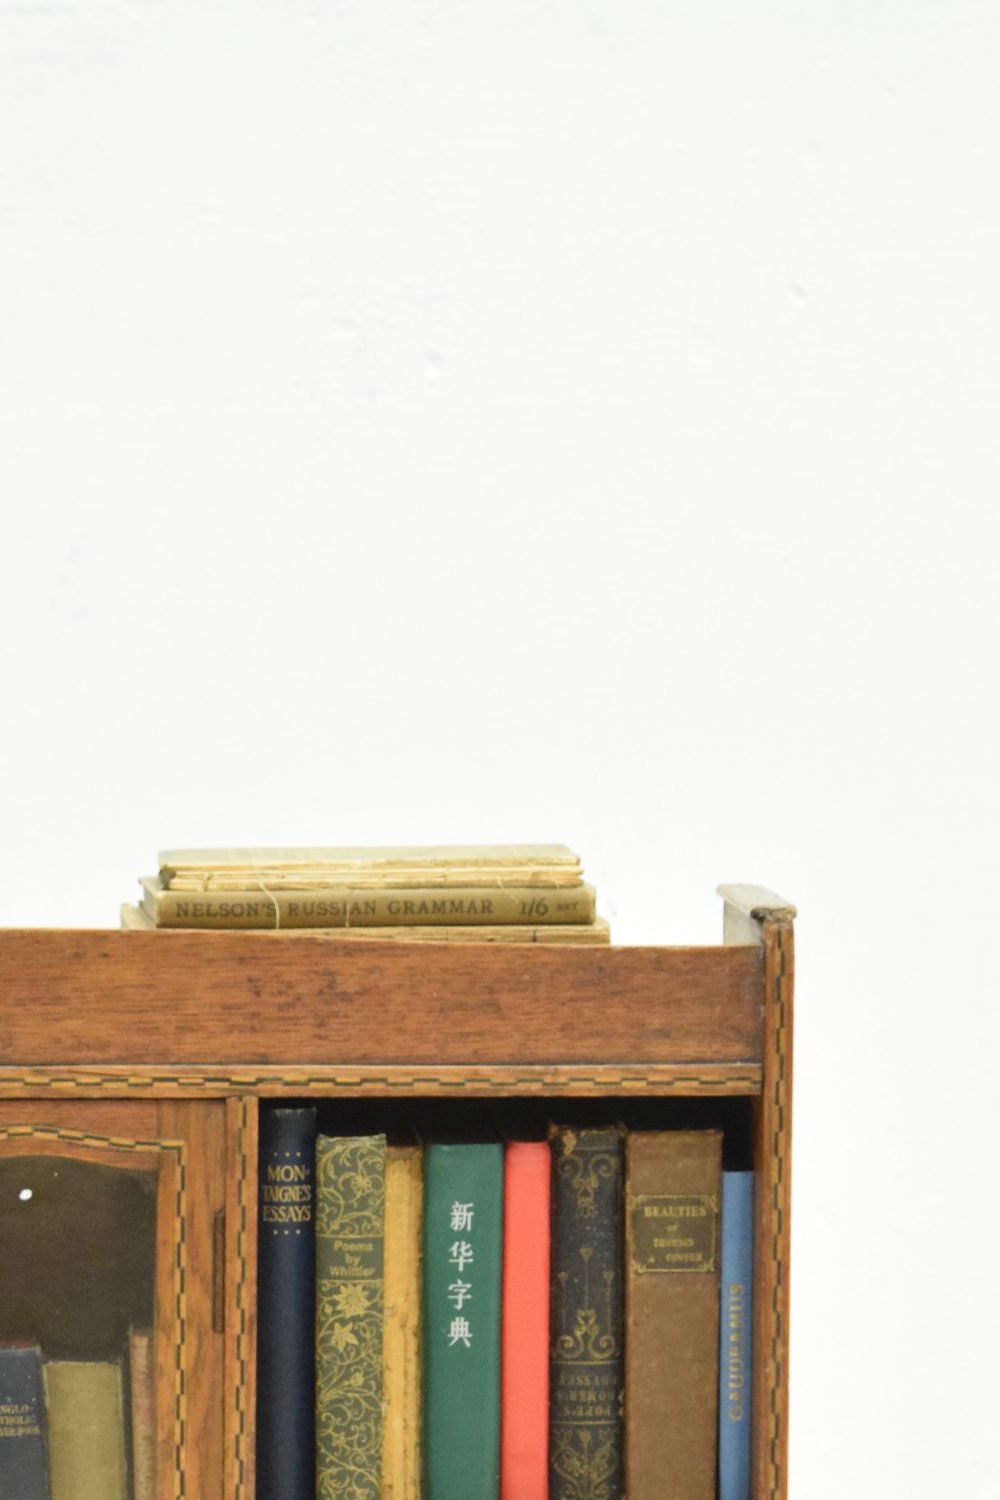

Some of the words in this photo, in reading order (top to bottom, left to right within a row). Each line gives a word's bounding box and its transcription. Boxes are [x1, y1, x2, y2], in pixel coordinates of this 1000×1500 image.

[176, 902, 277, 919] NELSON'S
[288, 900, 377, 918] RUSSIAN
[388, 898, 494, 916] GRAMMAR
[520, 897, 548, 918] 1/6
[267, 1165, 311, 1182] MON-
[263, 1184, 311, 1201] TAIGNE'S
[263, 1205, 312, 1222] ESSAYS
[643, 1205, 707, 1218] BEAUTIES
[334, 1239, 373, 1251] Poems
[344, 1253, 361, 1266] by
[329, 1265, 376, 1277] Whittier
[448, 1201, 475, 1348] 新华字典
